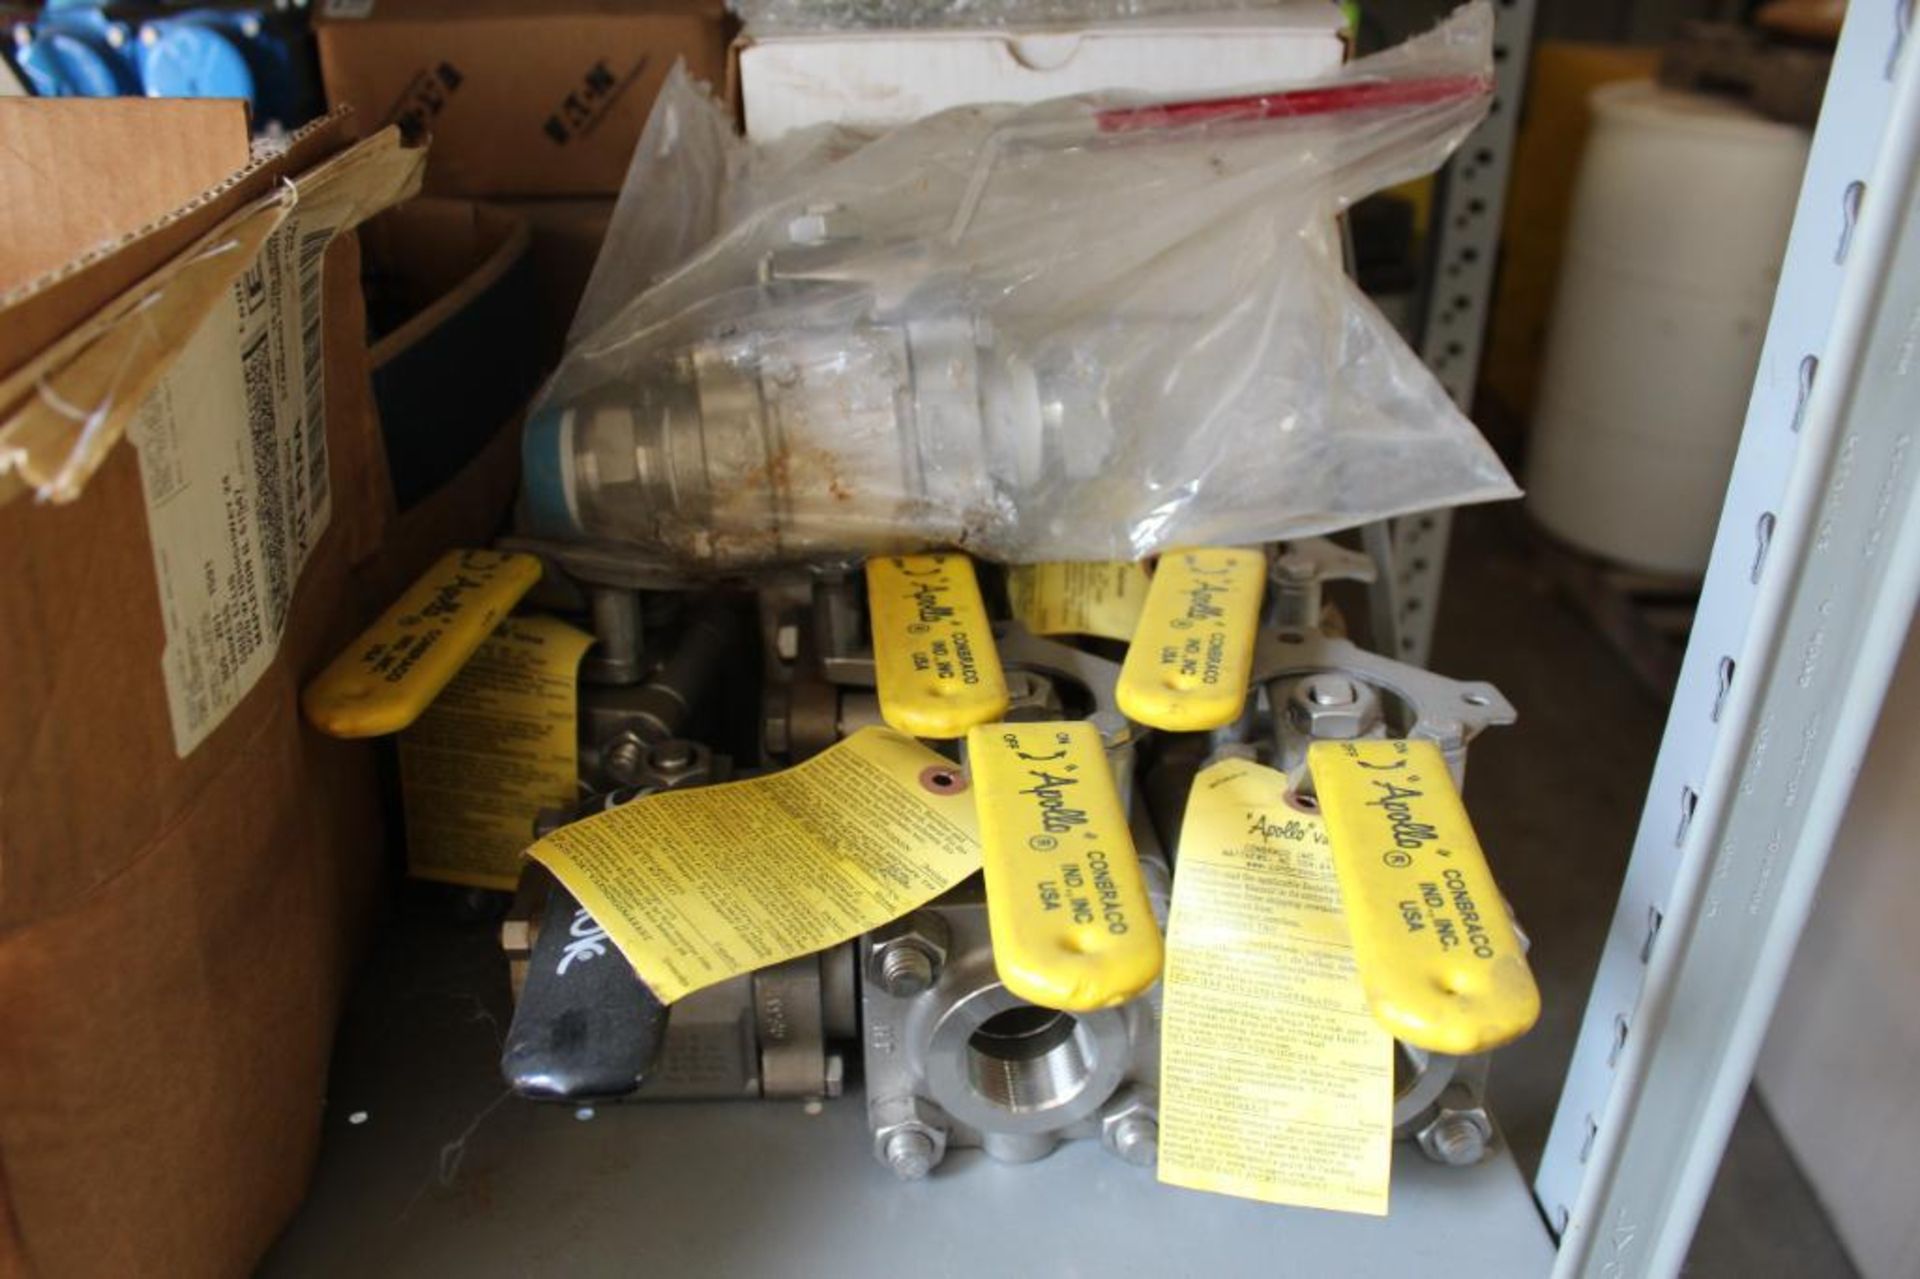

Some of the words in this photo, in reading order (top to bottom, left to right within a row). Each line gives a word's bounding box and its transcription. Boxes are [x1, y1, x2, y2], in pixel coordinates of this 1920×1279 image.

[1037, 881, 1062, 911] USA
[1087, 850, 1129, 936] CONBRACO
[1398, 900, 1426, 934] USA
[1442, 869, 1495, 960] CONBRACO
